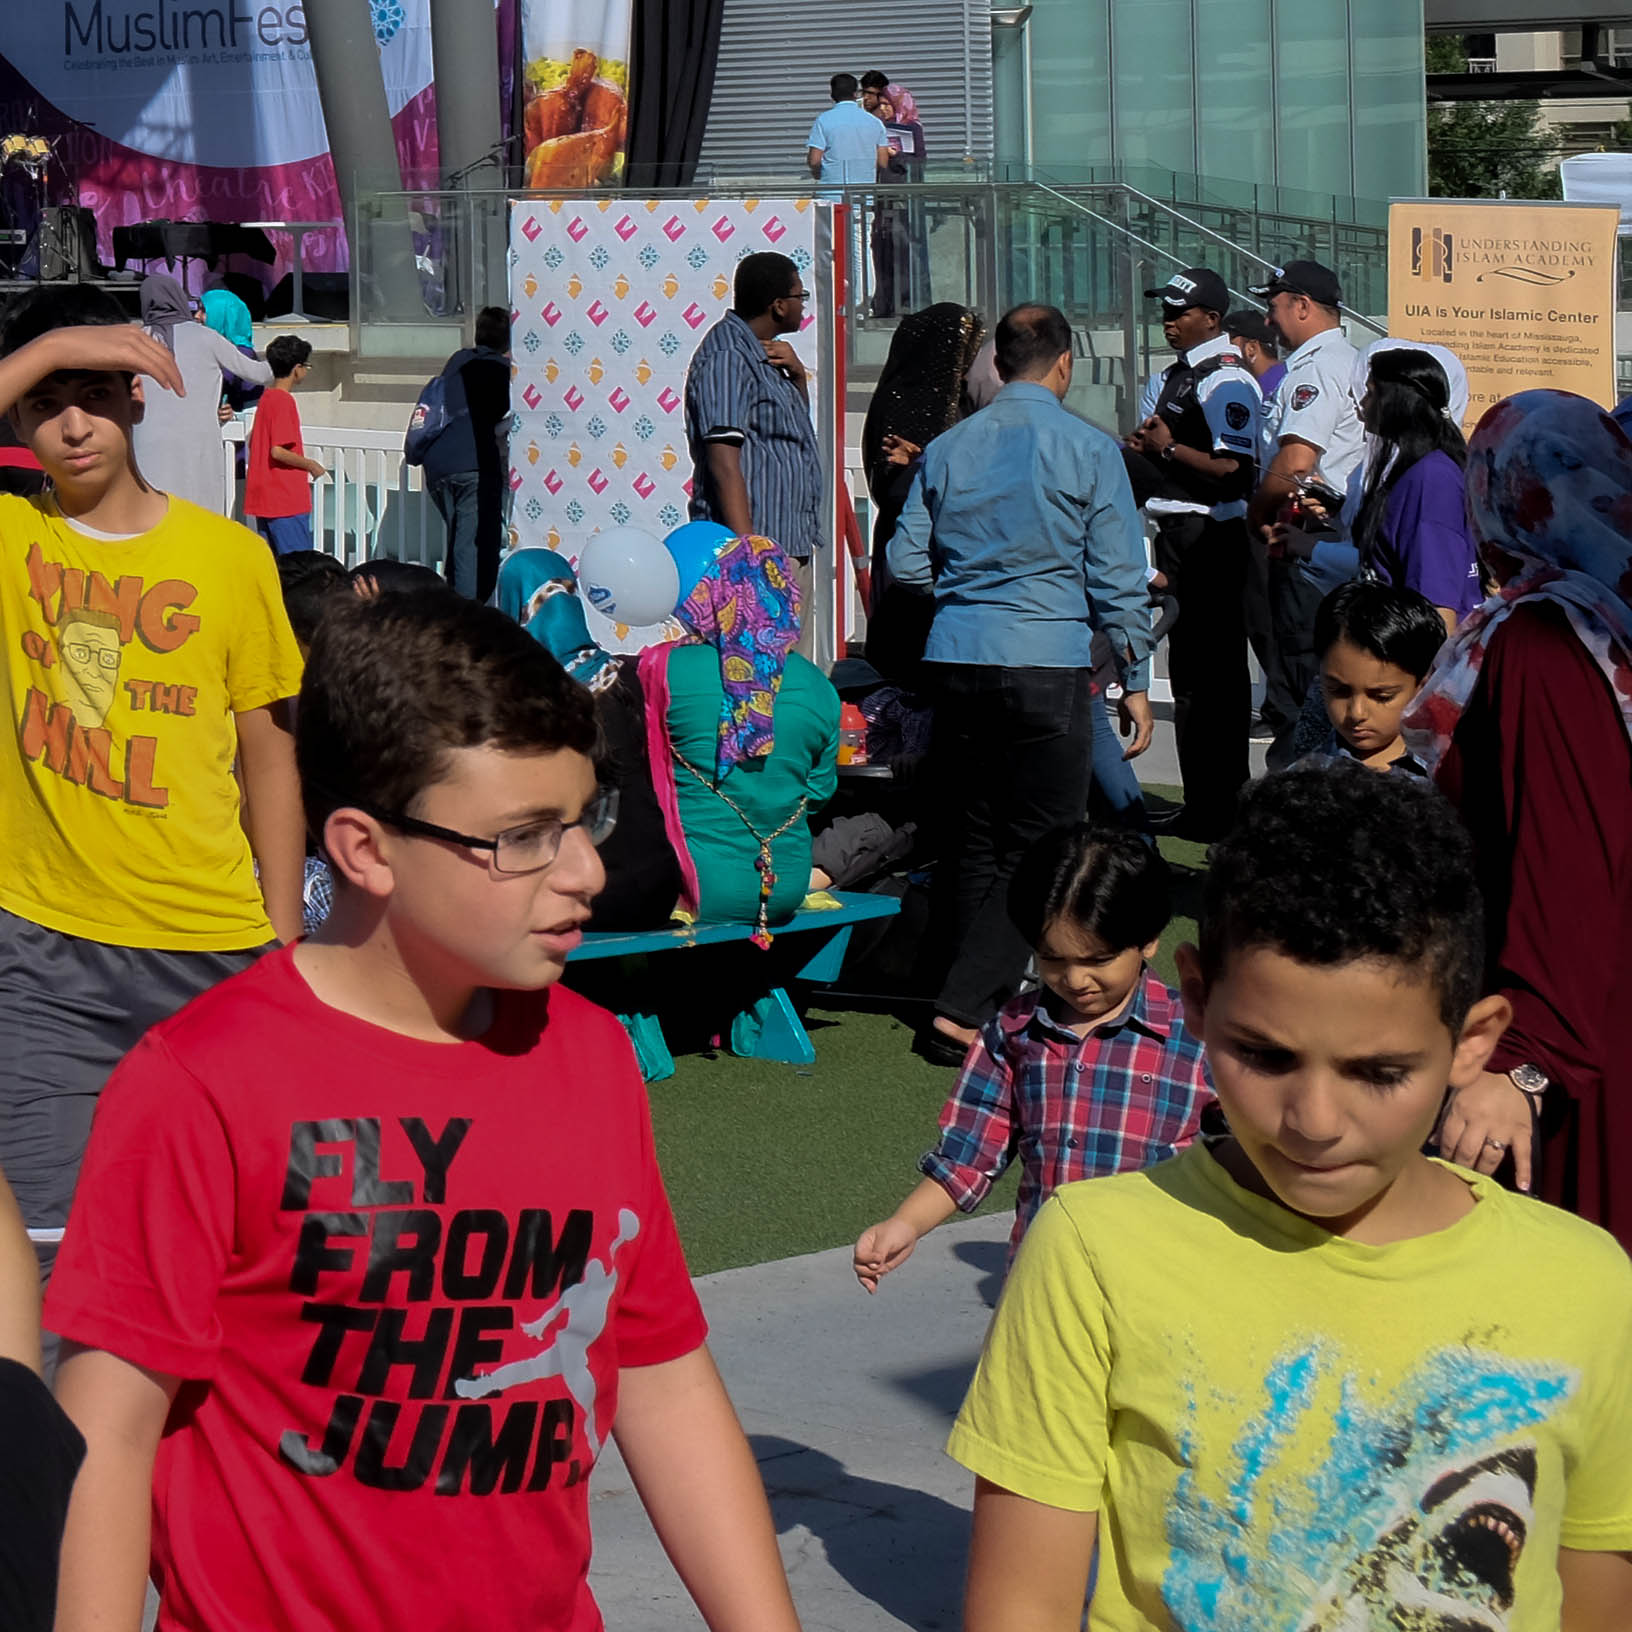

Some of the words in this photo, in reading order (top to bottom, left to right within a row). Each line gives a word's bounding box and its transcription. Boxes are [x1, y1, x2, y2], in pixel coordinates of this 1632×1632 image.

[1456, 252, 1505, 265] ISLAM
[1514, 253, 1597, 266] ACADEMY
[1460, 238, 1593, 253] UNDERSTANDING
[1405, 304, 1431, 318] UIA
[1436, 305, 1447, 318] is
[1452, 306, 1485, 319] Your
[1490, 307, 1543, 322] Islamic
[1548, 309, 1599, 324] Center
[1420, 327, 1456, 337] Located
[1459, 328, 1467, 337] in
[1469, 329, 1484, 338] the
[1486, 329, 1509, 339] heart
[1511, 330, 1521, 339] of
[1493, 354, 1539, 365] Education
[25, 541, 201, 654] KING
[123, 678, 199, 717] THE
[20, 684, 169, 809] HILL
[280, 1115, 474, 1211] FLY
[288, 1208, 595, 1304] FROM
[299, 1301, 515, 1401] THE
[278, 1394, 582, 1497] JUMP.
